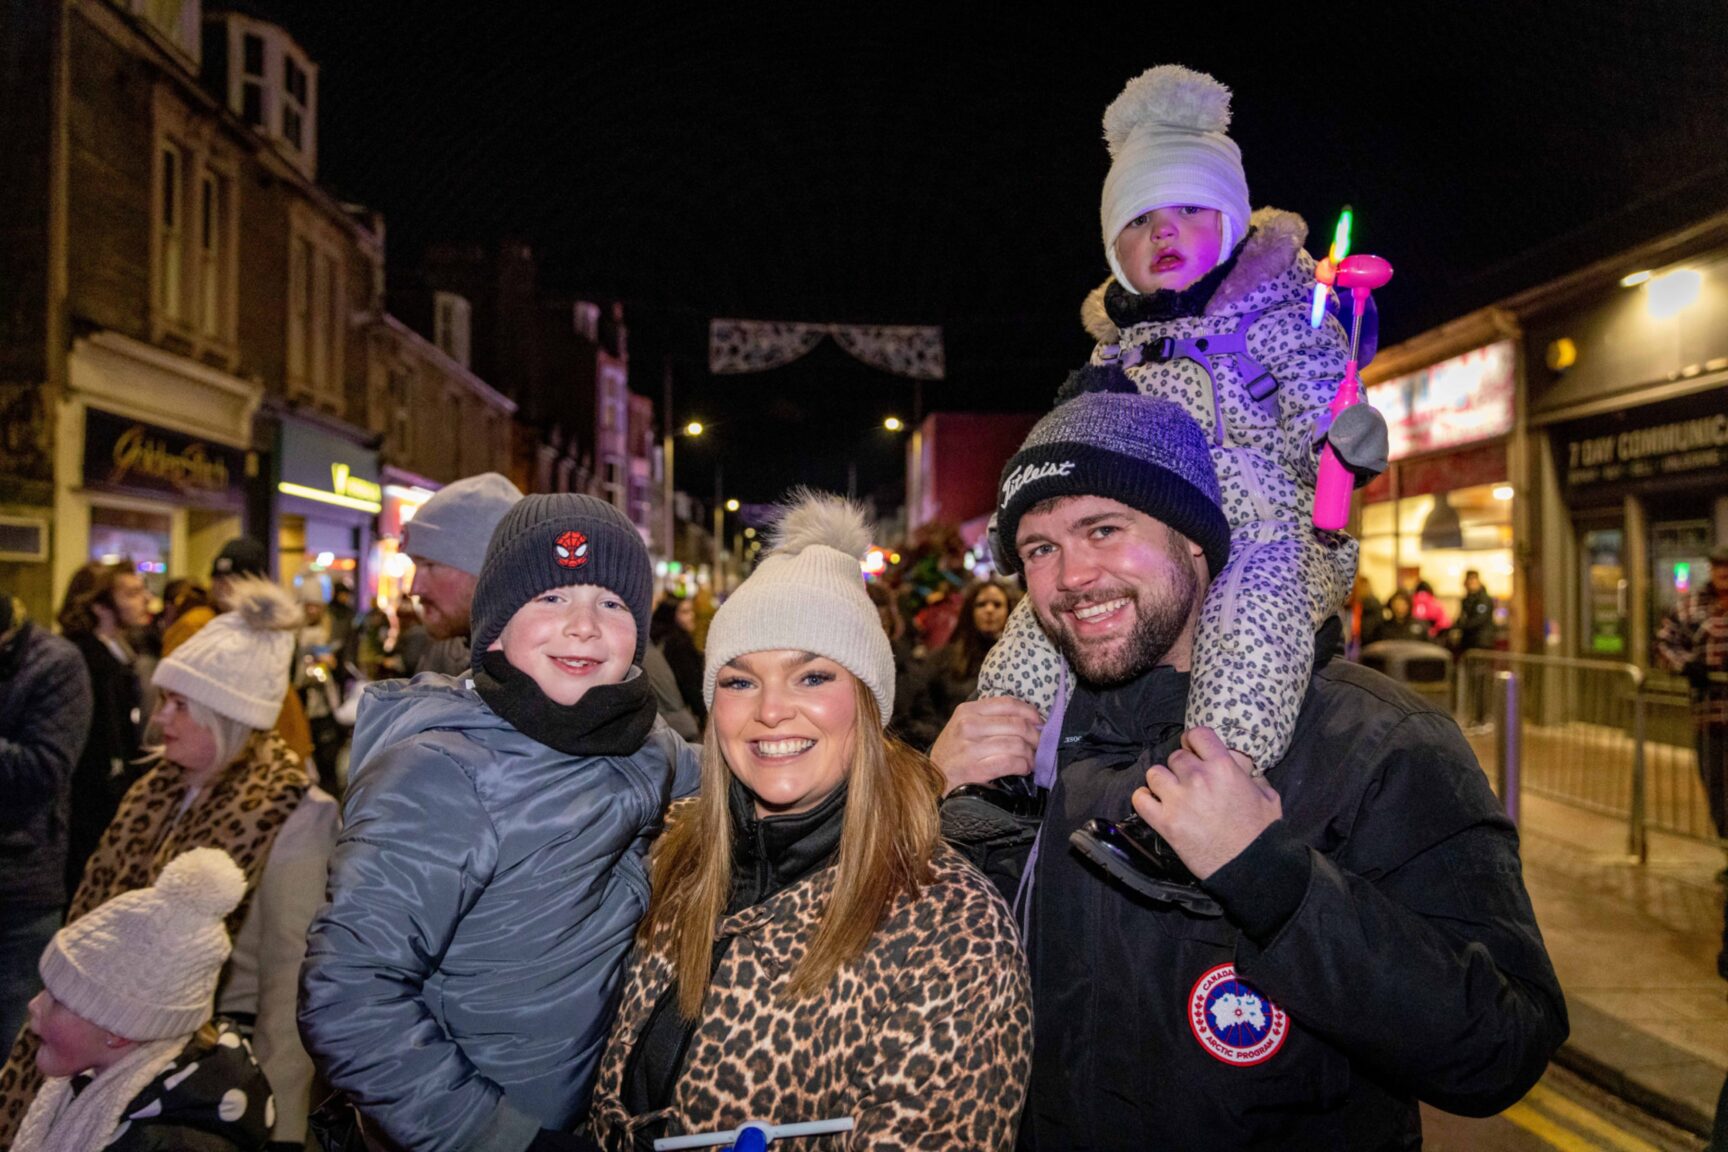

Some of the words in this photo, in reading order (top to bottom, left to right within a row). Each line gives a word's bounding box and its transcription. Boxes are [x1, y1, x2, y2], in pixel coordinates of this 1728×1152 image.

[1581, 436, 1615, 466] DAY
[1617, 414, 1728, 461] COMMUNIC
[1000, 460, 1075, 509] Titleist
[1203, 969, 1235, 991] CANADA
[1206, 1036, 1234, 1057] ARCTIC
[1236, 1038, 1274, 1059] PROGRAM
